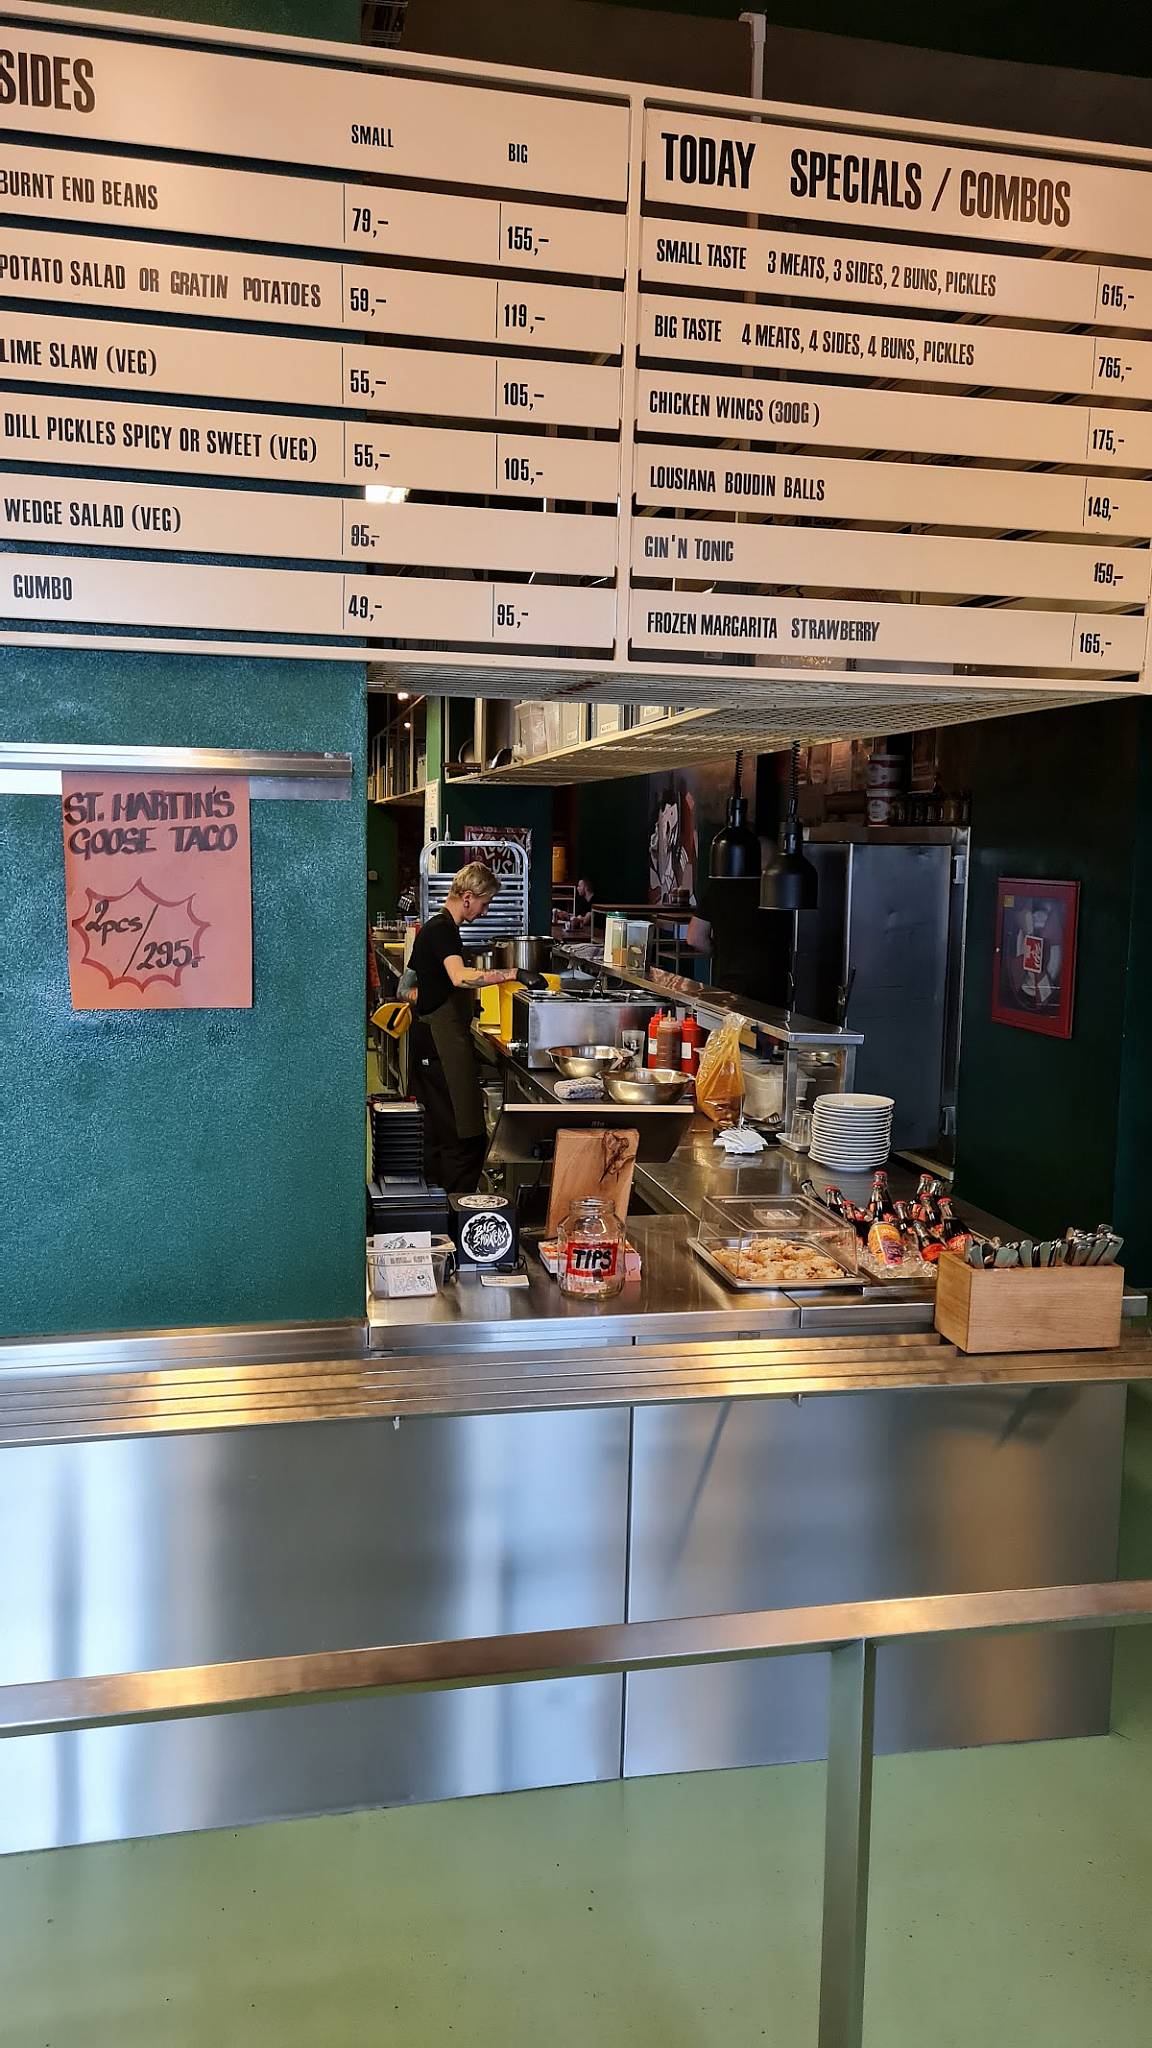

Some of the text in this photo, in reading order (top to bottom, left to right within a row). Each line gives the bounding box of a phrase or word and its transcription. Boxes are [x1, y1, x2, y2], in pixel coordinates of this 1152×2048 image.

[0, 49, 95, 113] SIDES
[352, 125, 394, 147] SMALL
[509, 143, 527, 163] BIG
[0, 170, 158, 210] BURNT END BEANS
[661, 133, 1070, 227] TODAY SPECIALS / COMBOS
[0, 254, 321, 307] POTATO SALAD OR GRATIN POTATOES
[657, 239, 996, 296] SMALL TASTE 3 MEATS, 3 SIDES, 2 BUNS, PICKLES
[0, 339, 156, 376] LIME SLAW (VEG)
[655, 315, 974, 365] BIG TASTE 4 MEATS, 4 SIDES, 4 BUNS, PICKLES
[650, 391, 710, 416] CHICKEN
[716, 396, 763, 421] WINGS
[5, 413, 316, 463] DILL PICKLES SPICY OR SWEET (VEG)
[651, 466, 824, 501] LOUSIANA BOUDIN BALLS
[4, 498, 180, 533] WEDGE SALAD (VEG)
[695, 538, 733, 561] TONIC
[14, 575, 72, 600] GUMBO
[648, 612, 880, 641] FROZEN MARGARITA STRAWBERRY
[64, 785, 235, 825] ST. MARTIN'S
[68, 823, 238, 861] GOOSE TACO
[473, 1221, 497, 1240] BIG
[573, 1249, 611, 1269] TIPS
